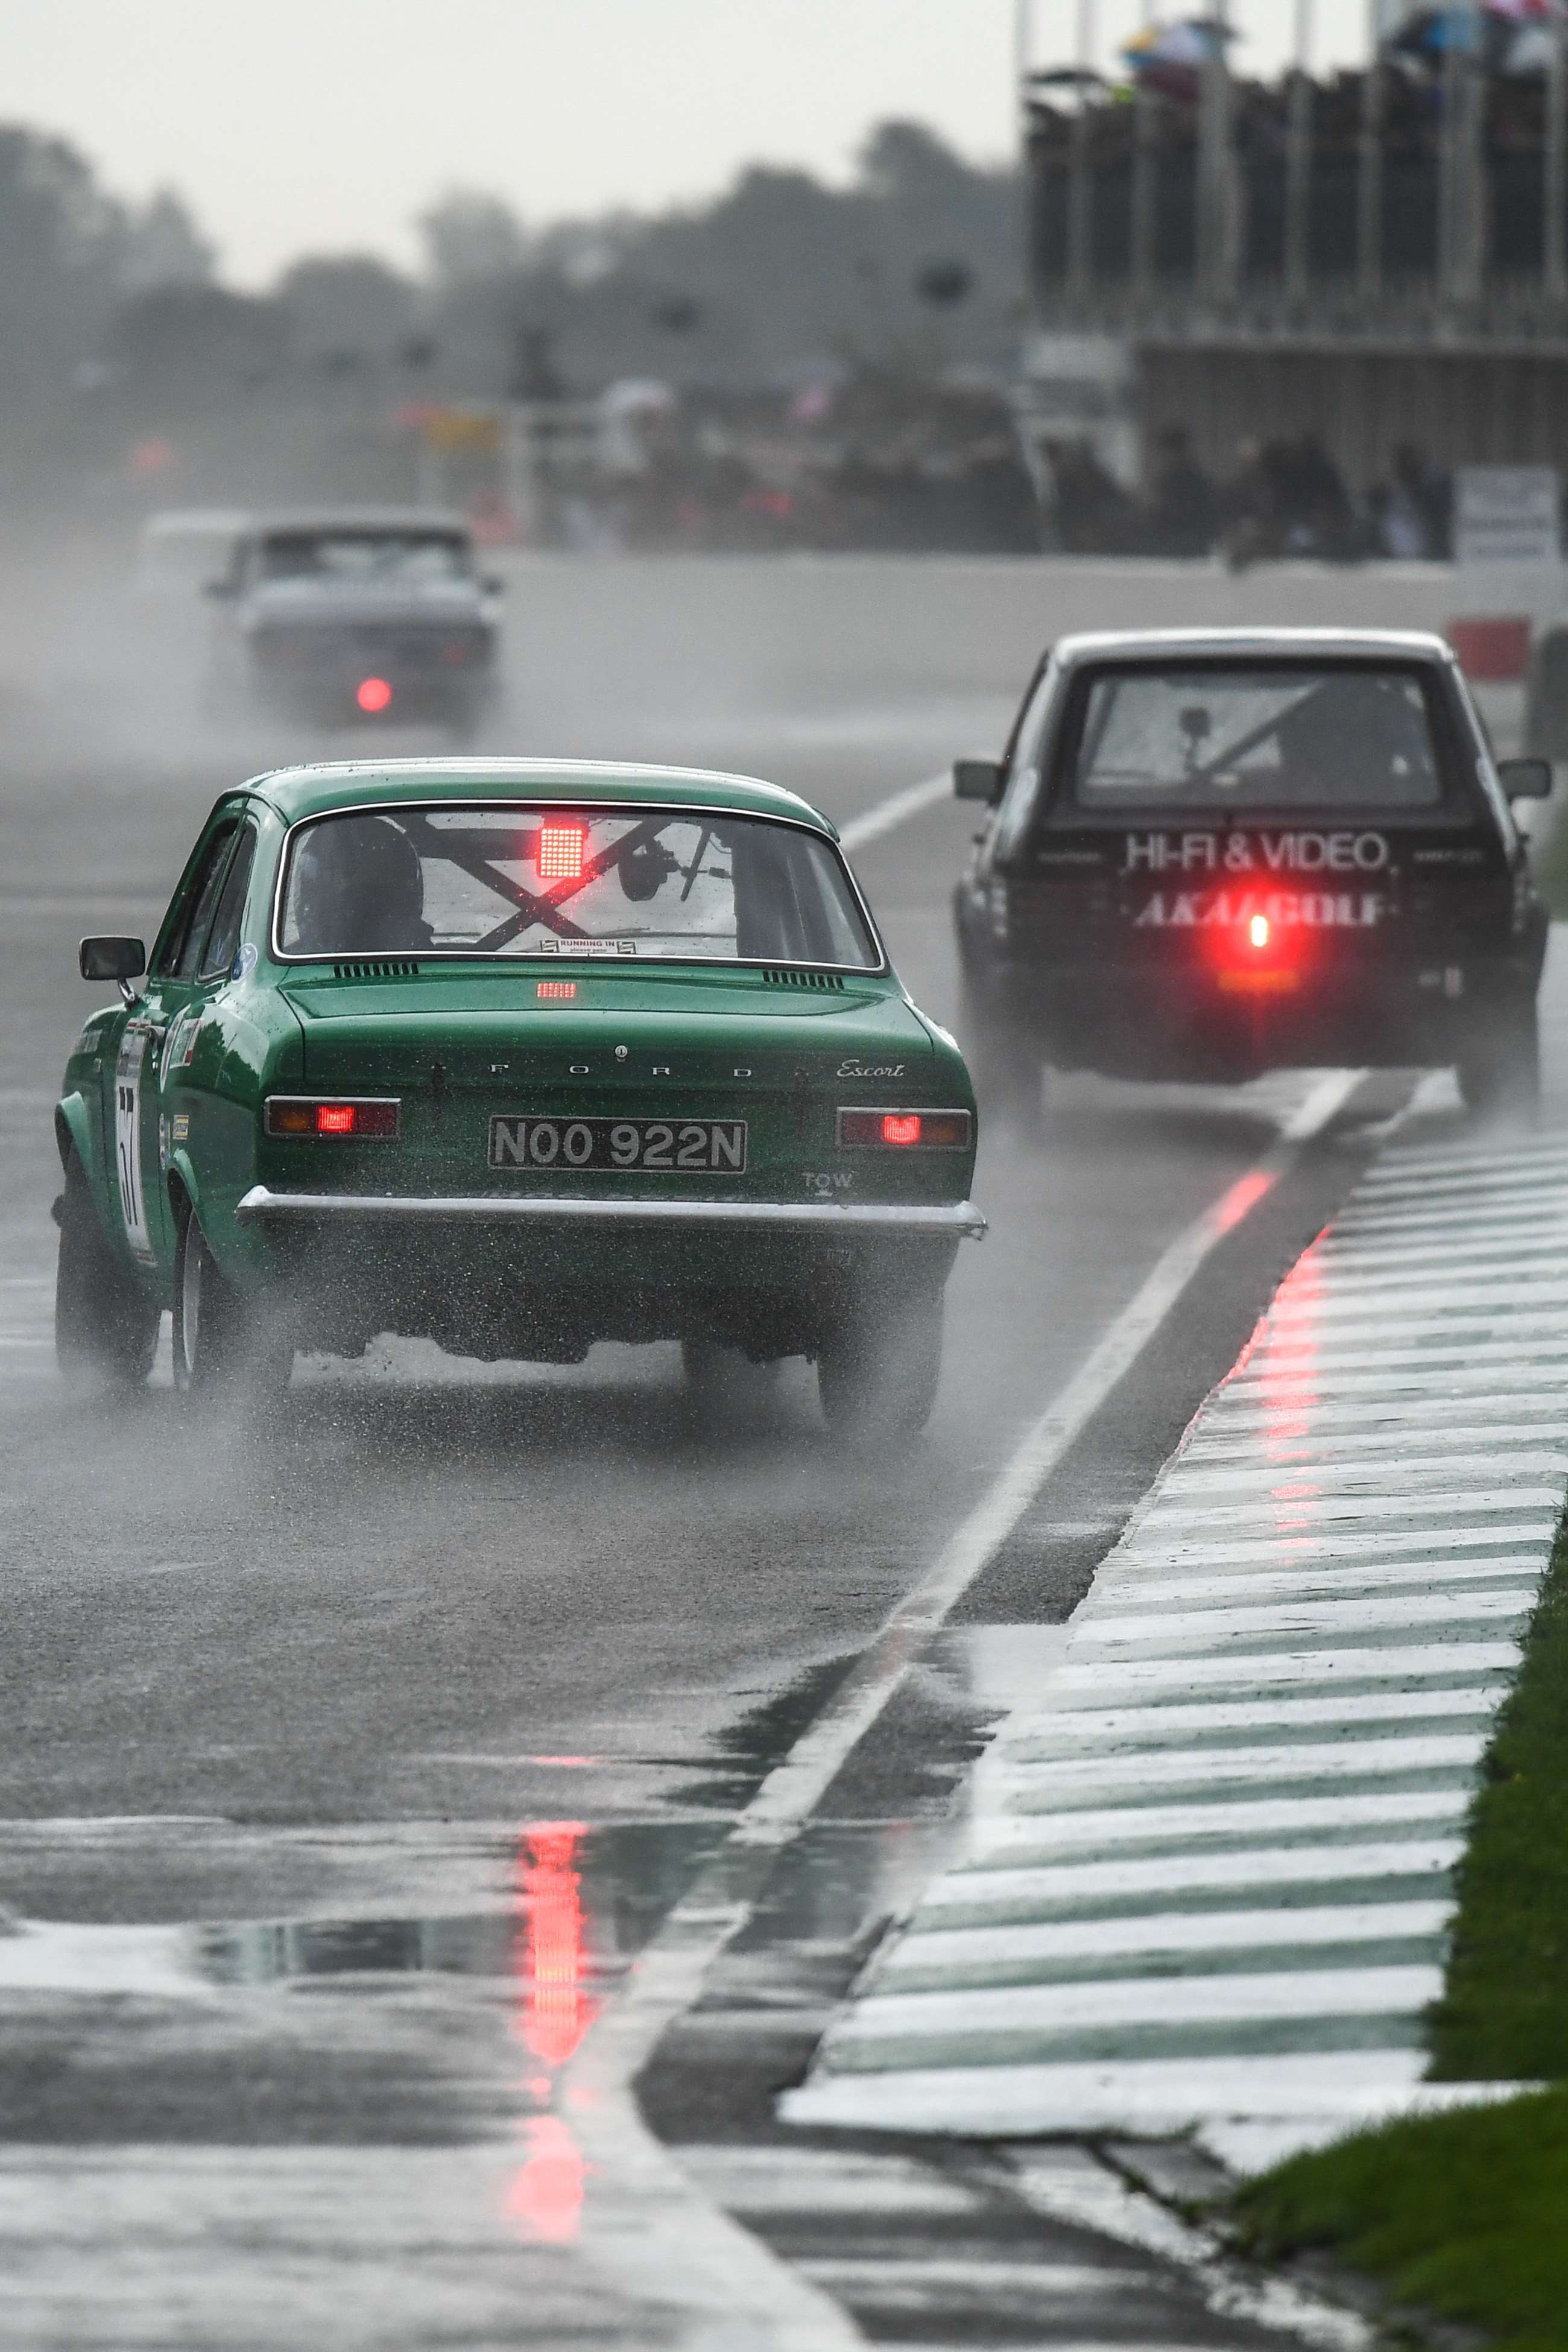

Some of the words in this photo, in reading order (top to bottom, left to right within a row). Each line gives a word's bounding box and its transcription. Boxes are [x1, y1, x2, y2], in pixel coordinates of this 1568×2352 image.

[1126, 832, 1216, 870] HI-FI
[1223, 832, 1253, 872] &
[1260, 832, 1388, 871] VIDEO
[490, 1064, 752, 1077] FORD
[836, 1059, 905, 1077] Escort
[495, 1121, 593, 1165] NOO
[610, 1124, 742, 1167] 922N
[801, 1172, 853, 1188] TOW
